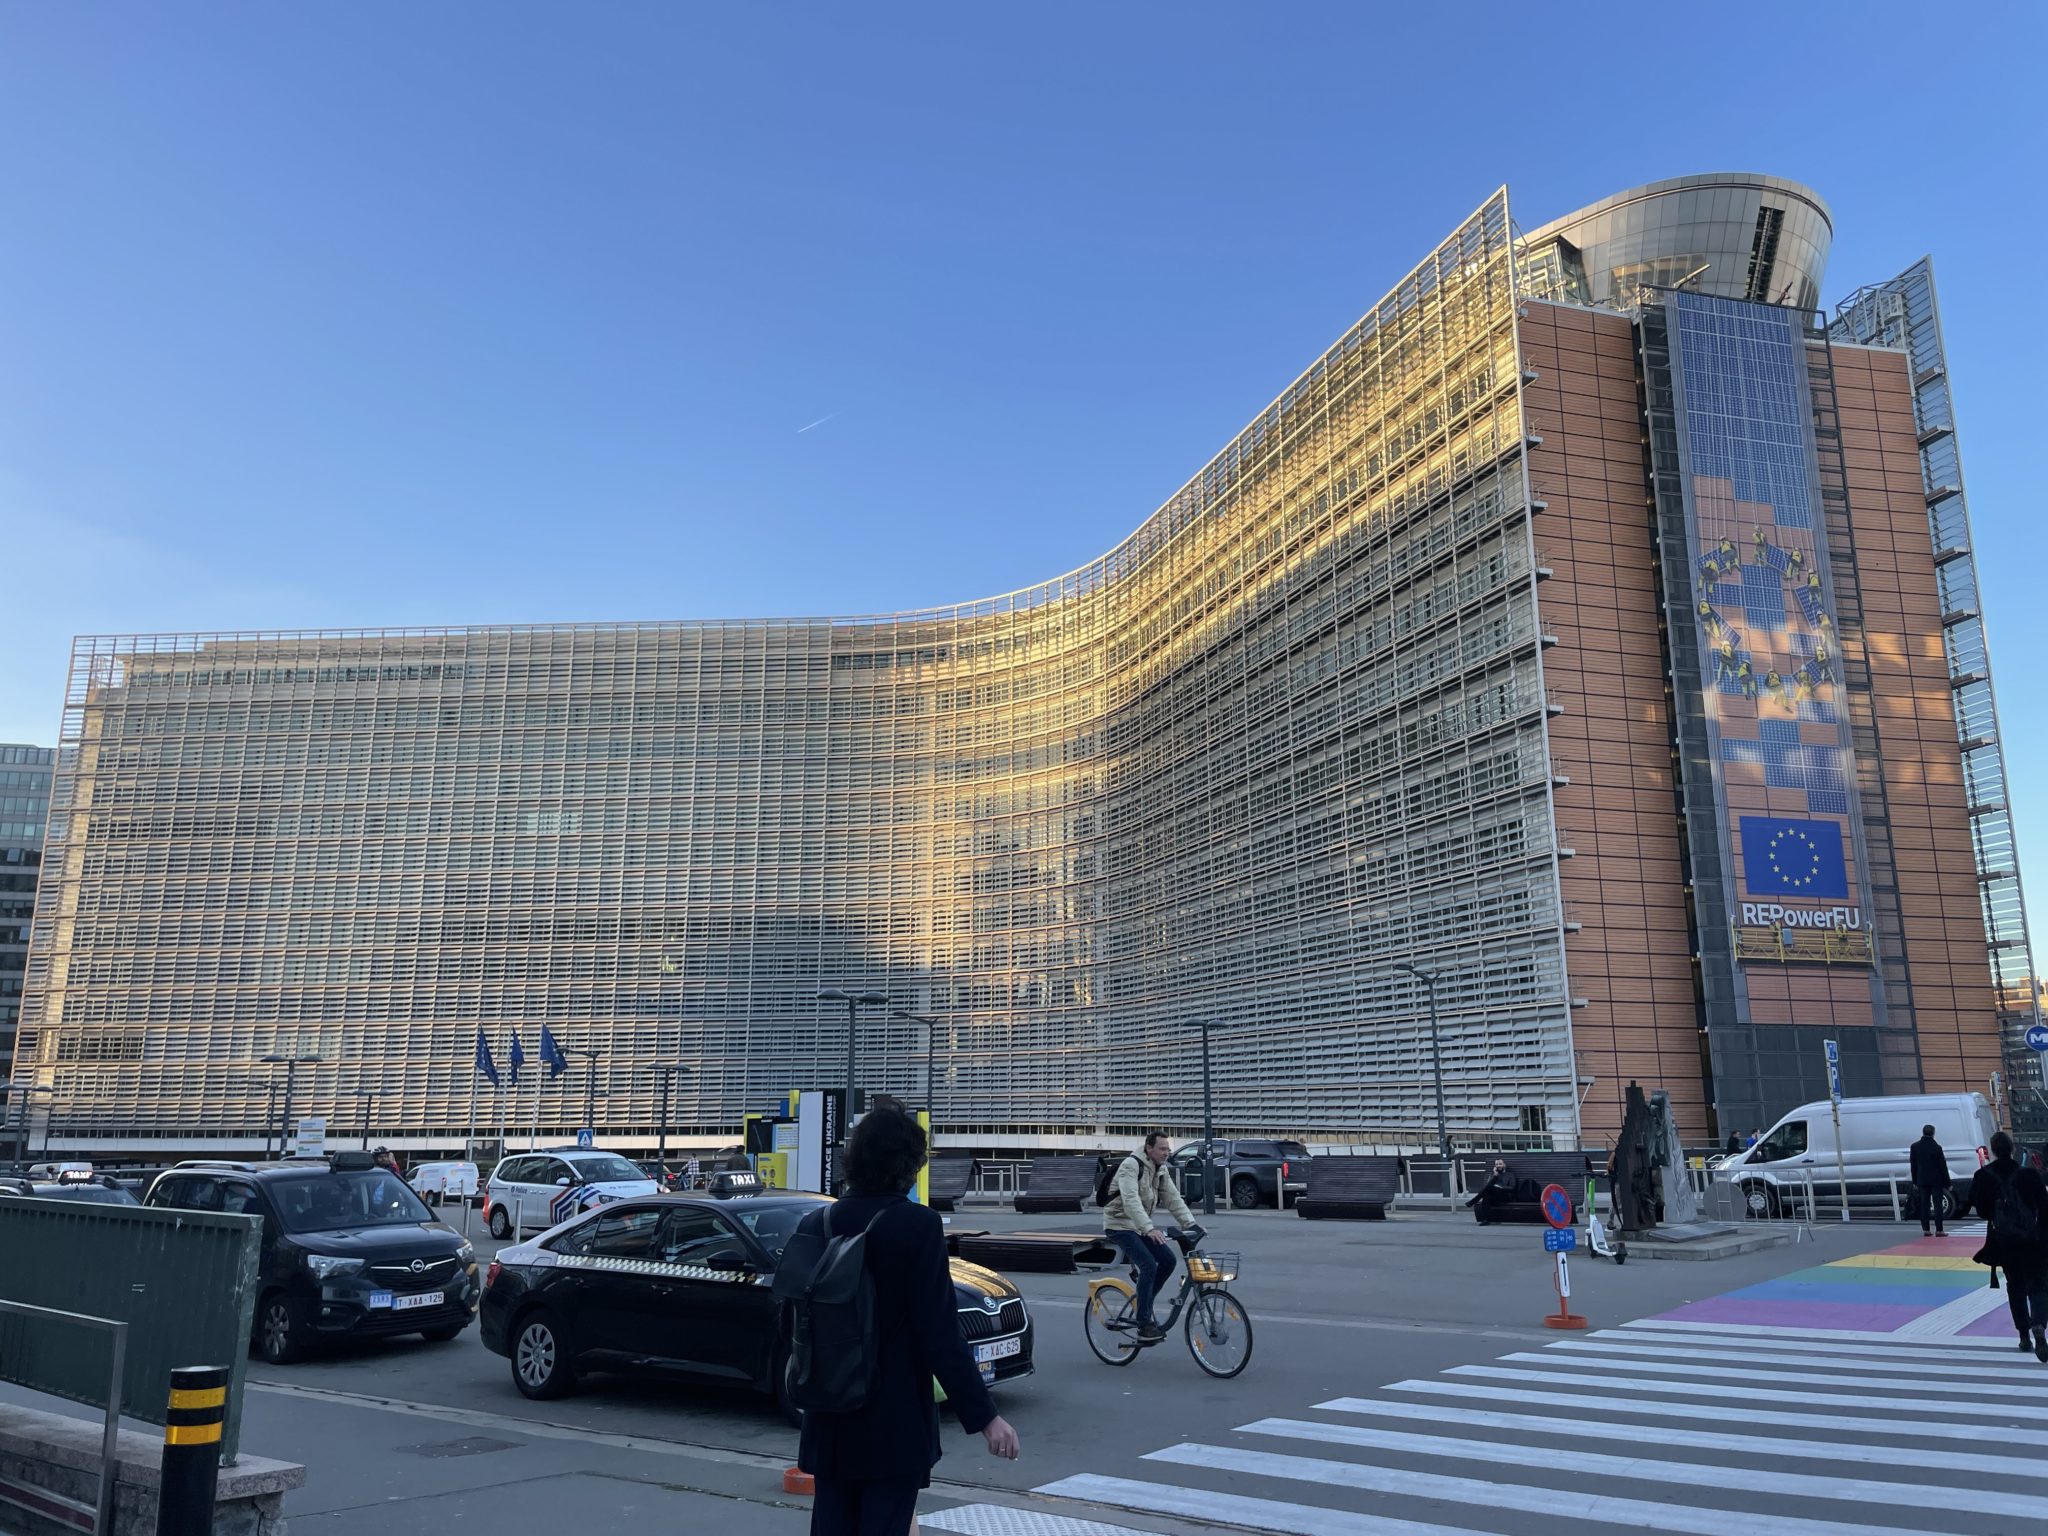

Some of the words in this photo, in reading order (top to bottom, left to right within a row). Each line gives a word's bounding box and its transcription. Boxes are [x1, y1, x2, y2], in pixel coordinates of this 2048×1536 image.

[1742, 903, 1860, 929] REPowerEU
[1831, 1066, 1838, 1088] P
[825, 1095, 833, 1145] UKRAINE
[730, 1174, 756, 1186] TAXI
